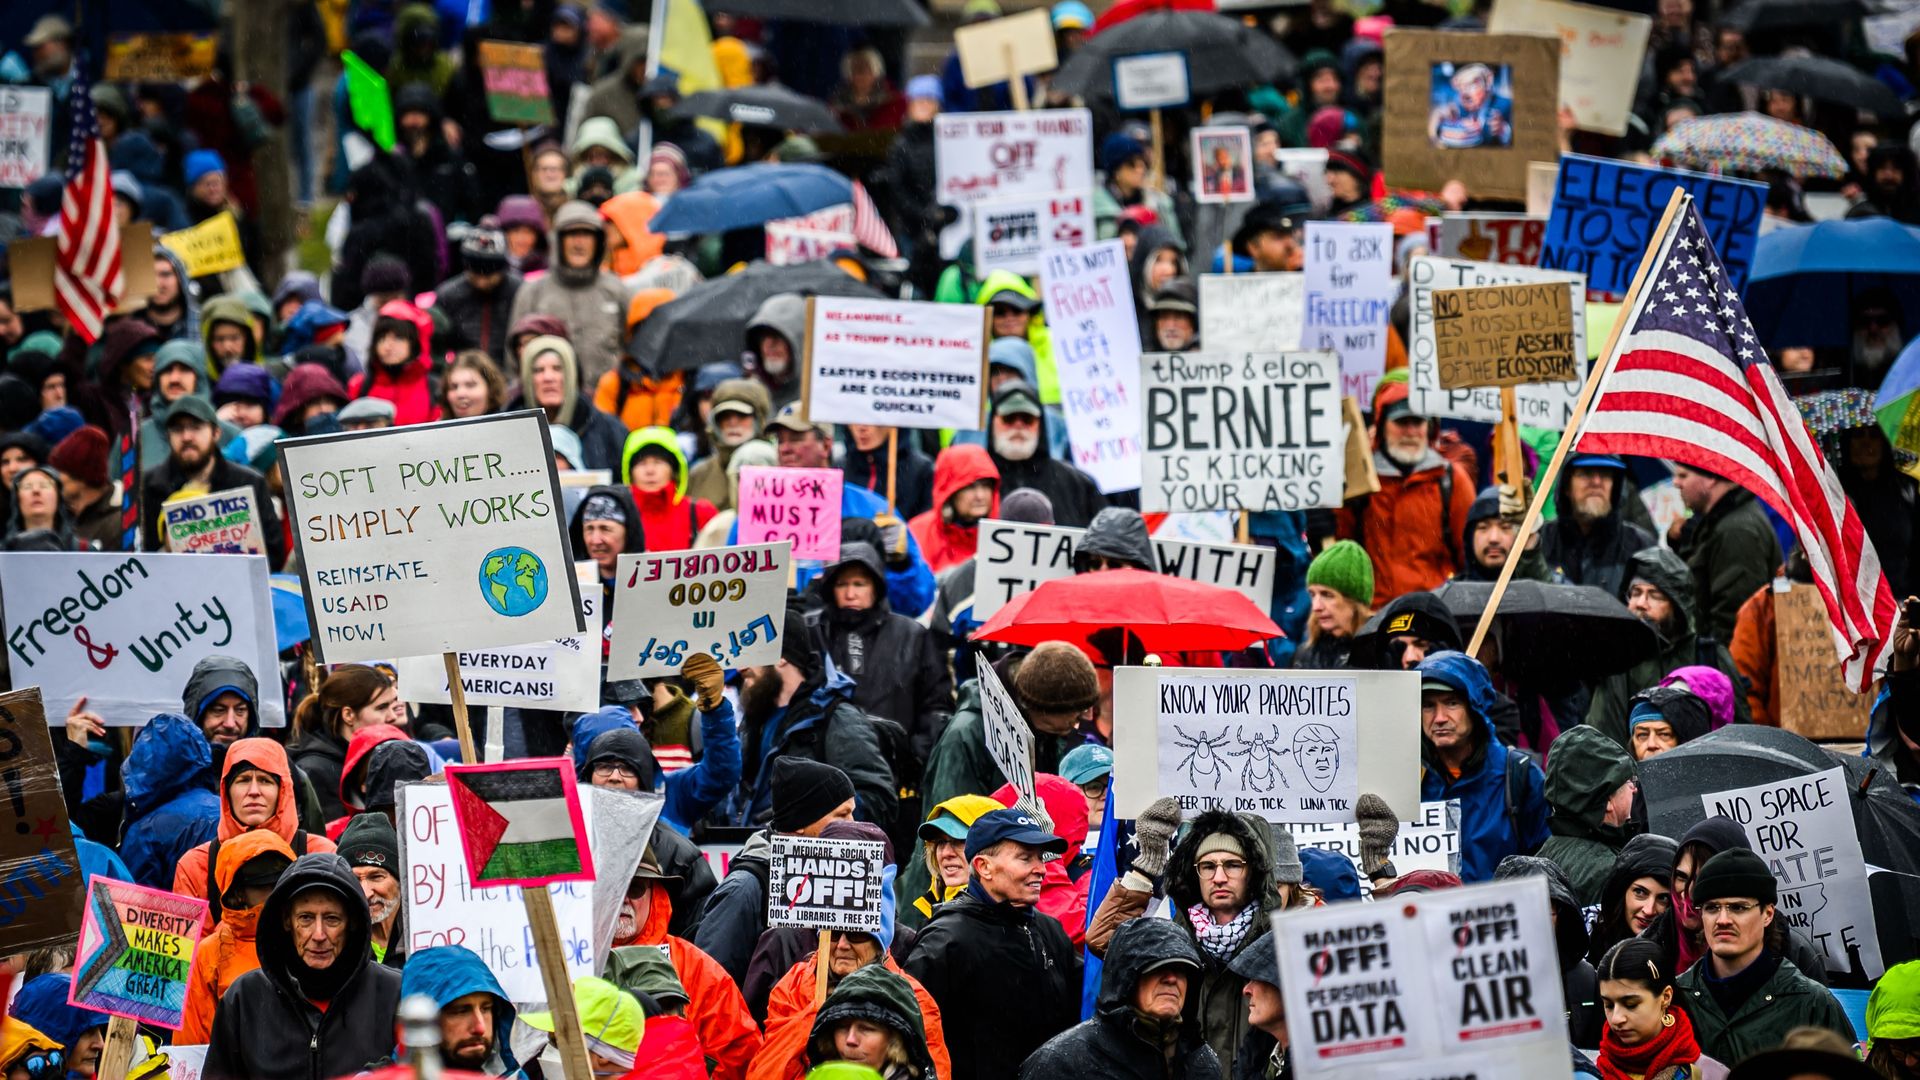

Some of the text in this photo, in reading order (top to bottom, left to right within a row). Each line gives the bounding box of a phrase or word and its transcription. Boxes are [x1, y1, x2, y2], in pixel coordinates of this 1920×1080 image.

[1560, 159, 1759, 232] ELECTED
[1556, 202, 1613, 247] TO
[1436, 286, 1560, 317] NO ECONOMY
[1438, 312, 1569, 338] IS POSSIBLE
[846, 333, 890, 344] TRUMP
[894, 337, 935, 348] PLAYS
[1440, 333, 1575, 358] IN THE ABSENCE
[820, 367, 975, 386] EARTH'S ECOSYSTEMS
[1243, 352, 1256, 381] &
[1264, 355, 1324, 379] elon
[1464, 359, 1493, 382] THE
[1497, 355, 1576, 379] ECOSYSTEM
[840, 384, 961, 400] ARE COLLAPSING
[873, 401, 935, 414] QUICKLY
[1147, 382, 1331, 451] BERNIE
[1161, 453, 1324, 482] IS KICKING
[300, 466, 377, 499] SOFT
[1161, 480, 1322, 511] YOUR ASS
[166, 496, 249, 525] END THIS
[307, 489, 550, 543] SIMPLY WORKS
[752, 504, 820, 528] MUST
[188, 523, 251, 549] GREED!
[627, 549, 779, 589] TROUBLE!
[989, 528, 1263, 587] STA WITH
[316, 560, 429, 587] REINSTATE
[322, 594, 389, 614] USAID
[669, 578, 747, 607] GOOD
[7, 556, 149, 668] Freedom
[74, 624, 119, 671] &
[128, 595, 233, 673] Unity
[327, 623, 386, 643] NOW!
[458, 652, 548, 671] EVERYDAY
[638, 637, 689, 667] get
[978, 664, 1024, 755] Restore
[1160, 683, 1351, 716] KNOW YOUR PARASITES
[987, 710, 1031, 801] USAID
[1201, 796, 1226, 811] TICK
[1235, 796, 1287, 811] DOG TICK
[1300, 797, 1351, 811] LUNA TICK
[1715, 777, 1833, 825] NO SPACE
[412, 804, 449, 845] OF
[1756, 820, 1804, 855] FOR
[792, 845, 833, 857] MEDICARE
[840, 848, 867, 860] SOCIAL
[1404, 832, 1457, 856] NOT
[786, 857, 866, 878] HANDS
[1769, 845, 1839, 885] ATE
[413, 863, 445, 910] BY
[786, 876, 865, 907] OFF!
[1782, 891, 1803, 909] IN
[126, 908, 194, 937] DIVERSITY
[796, 910, 837, 922] LIBRARIES
[843, 913, 862, 924] FREE
[1449, 902, 1516, 924] HANDS
[1786, 912, 1810, 929] UR
[134, 929, 181, 956] MAKES
[1304, 921, 1387, 949] HANDS
[1451, 919, 1519, 948] OFF!
[474, 927, 519, 972] the
[1308, 942, 1391, 978] OFF!
[122, 950, 183, 980] AMERICA
[1452, 947, 1528, 982] CLEAN
[126, 972, 171, 1001] GREAT
[1306, 978, 1402, 1008] PERSONAL
[1461, 975, 1536, 1026] AIR
[1311, 999, 1406, 1045] DATA
